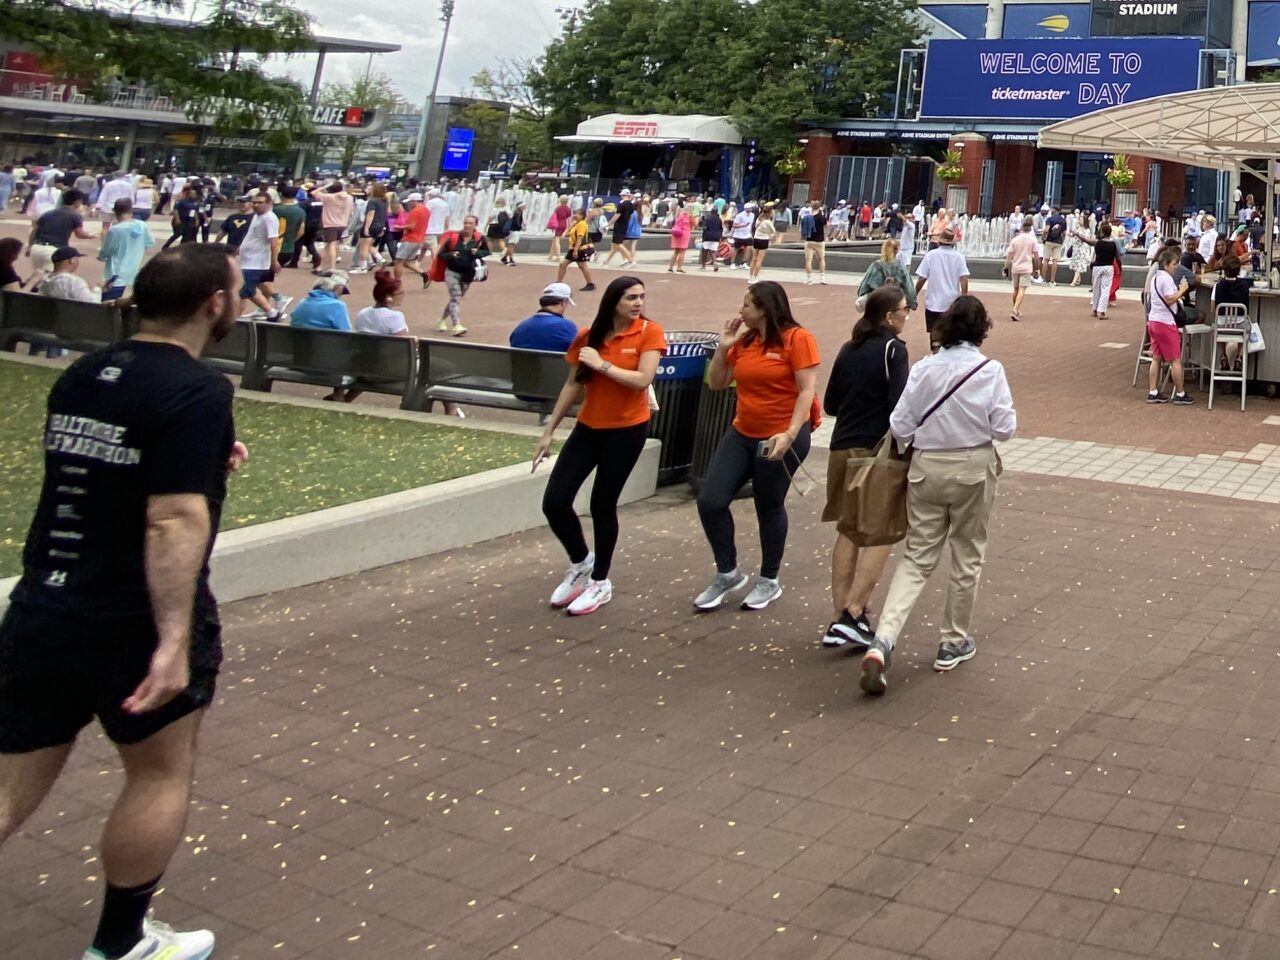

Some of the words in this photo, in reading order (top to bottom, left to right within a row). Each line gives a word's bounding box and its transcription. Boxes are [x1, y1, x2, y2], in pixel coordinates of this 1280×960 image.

[1118, 3, 1178, 15] STADIUM
[980, 52, 1101, 74] WELCOME
[1109, 52, 1142, 74] TO
[1077, 83, 1131, 105] DAY
[612, 121, 658, 136] ESPN
